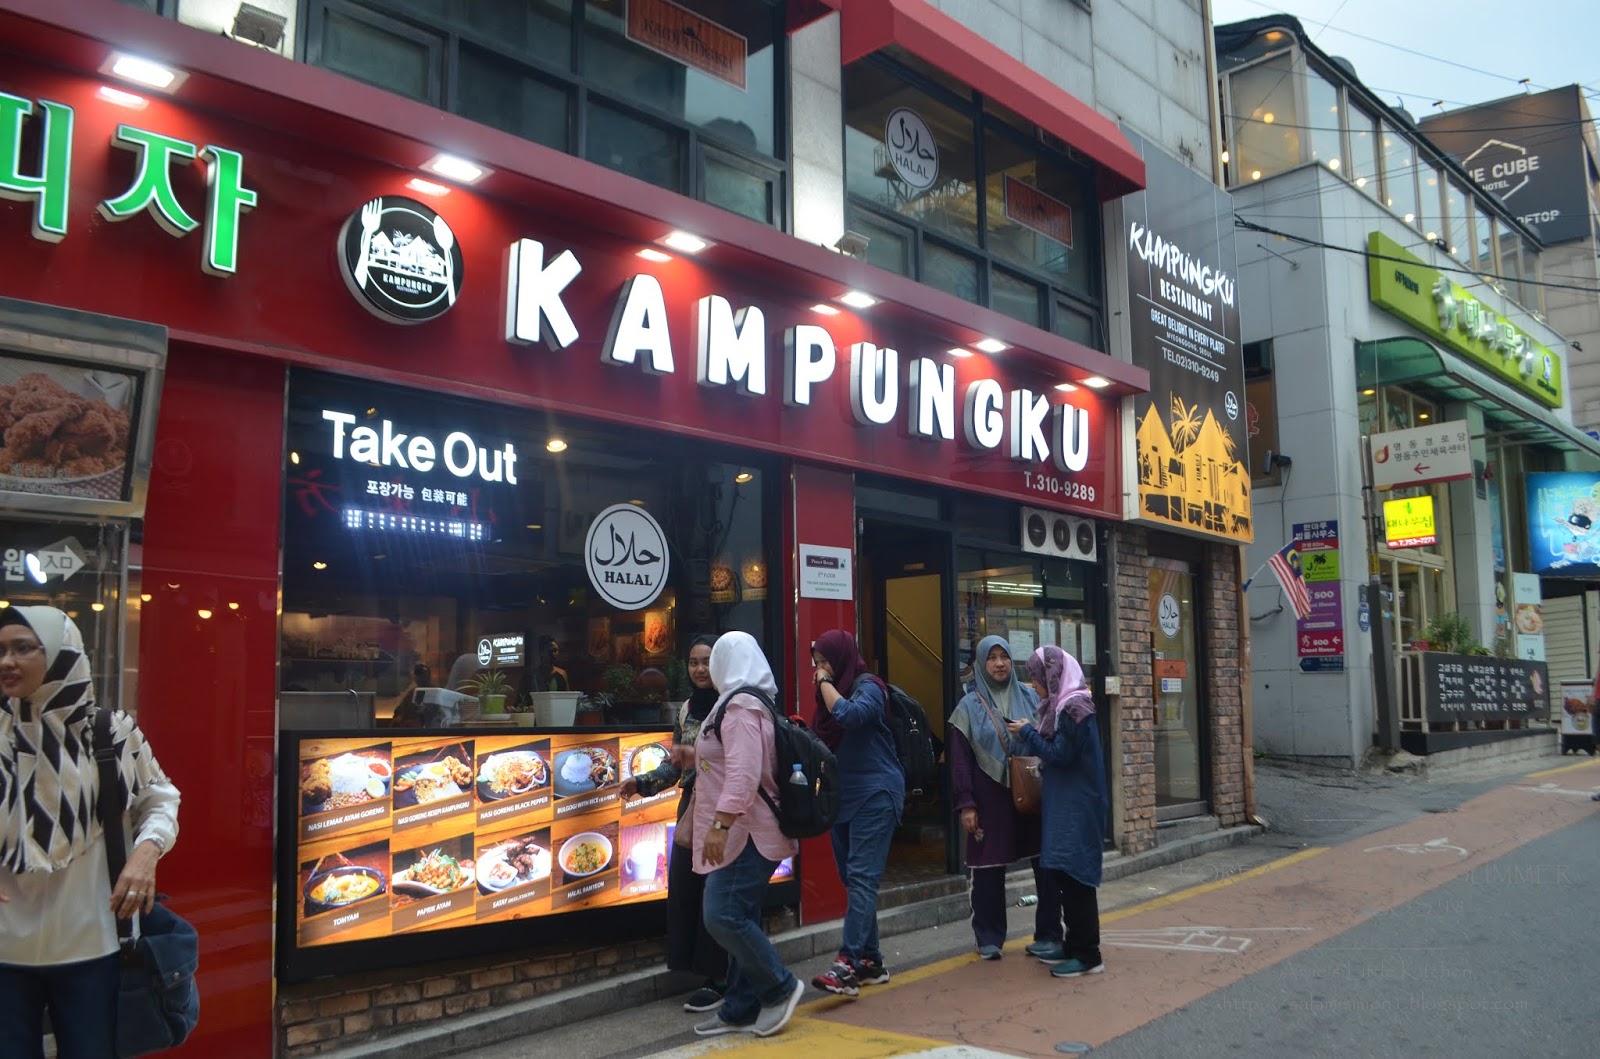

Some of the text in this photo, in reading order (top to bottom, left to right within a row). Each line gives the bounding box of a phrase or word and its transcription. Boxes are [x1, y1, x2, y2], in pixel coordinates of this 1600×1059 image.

[891, 116, 935, 161] حلال
[895, 152, 930, 180] HALAL
[1492, 155, 1540, 178] CUBE
[1482, 180, 1511, 192] HOTEL
[1516, 209, 1560, 225] OFTOP
[1129, 221, 1235, 309] KAMPUNGKU
[382, 272, 433, 295] KAMPUNGKU
[1160, 278, 1213, 322] RESTAURANT
[1150, 308, 1168, 327] GREAT
[1168, 315, 1188, 336] DELIGHT
[1194, 330, 1210, 347] EVERY
[506, 237, 1089, 472] KAMPUNGKU
[322, 409, 518, 485] Take Out
[366, 480, 415, 500] 포장가능
[1023, 471, 1096, 502] T.310-9289
[595, 522, 661, 567] حلال
[45, 555, 73, 570] 入口
[604, 571, 653, 588] HALAL
[307, 805, 384, 832] NASI LEMAK AYAM GORENG
[480, 795, 548, 819] NASI GORENG BLACK PEPPER
[397, 815, 408, 825] NASI
[435, 899, 452, 911] AYAM
